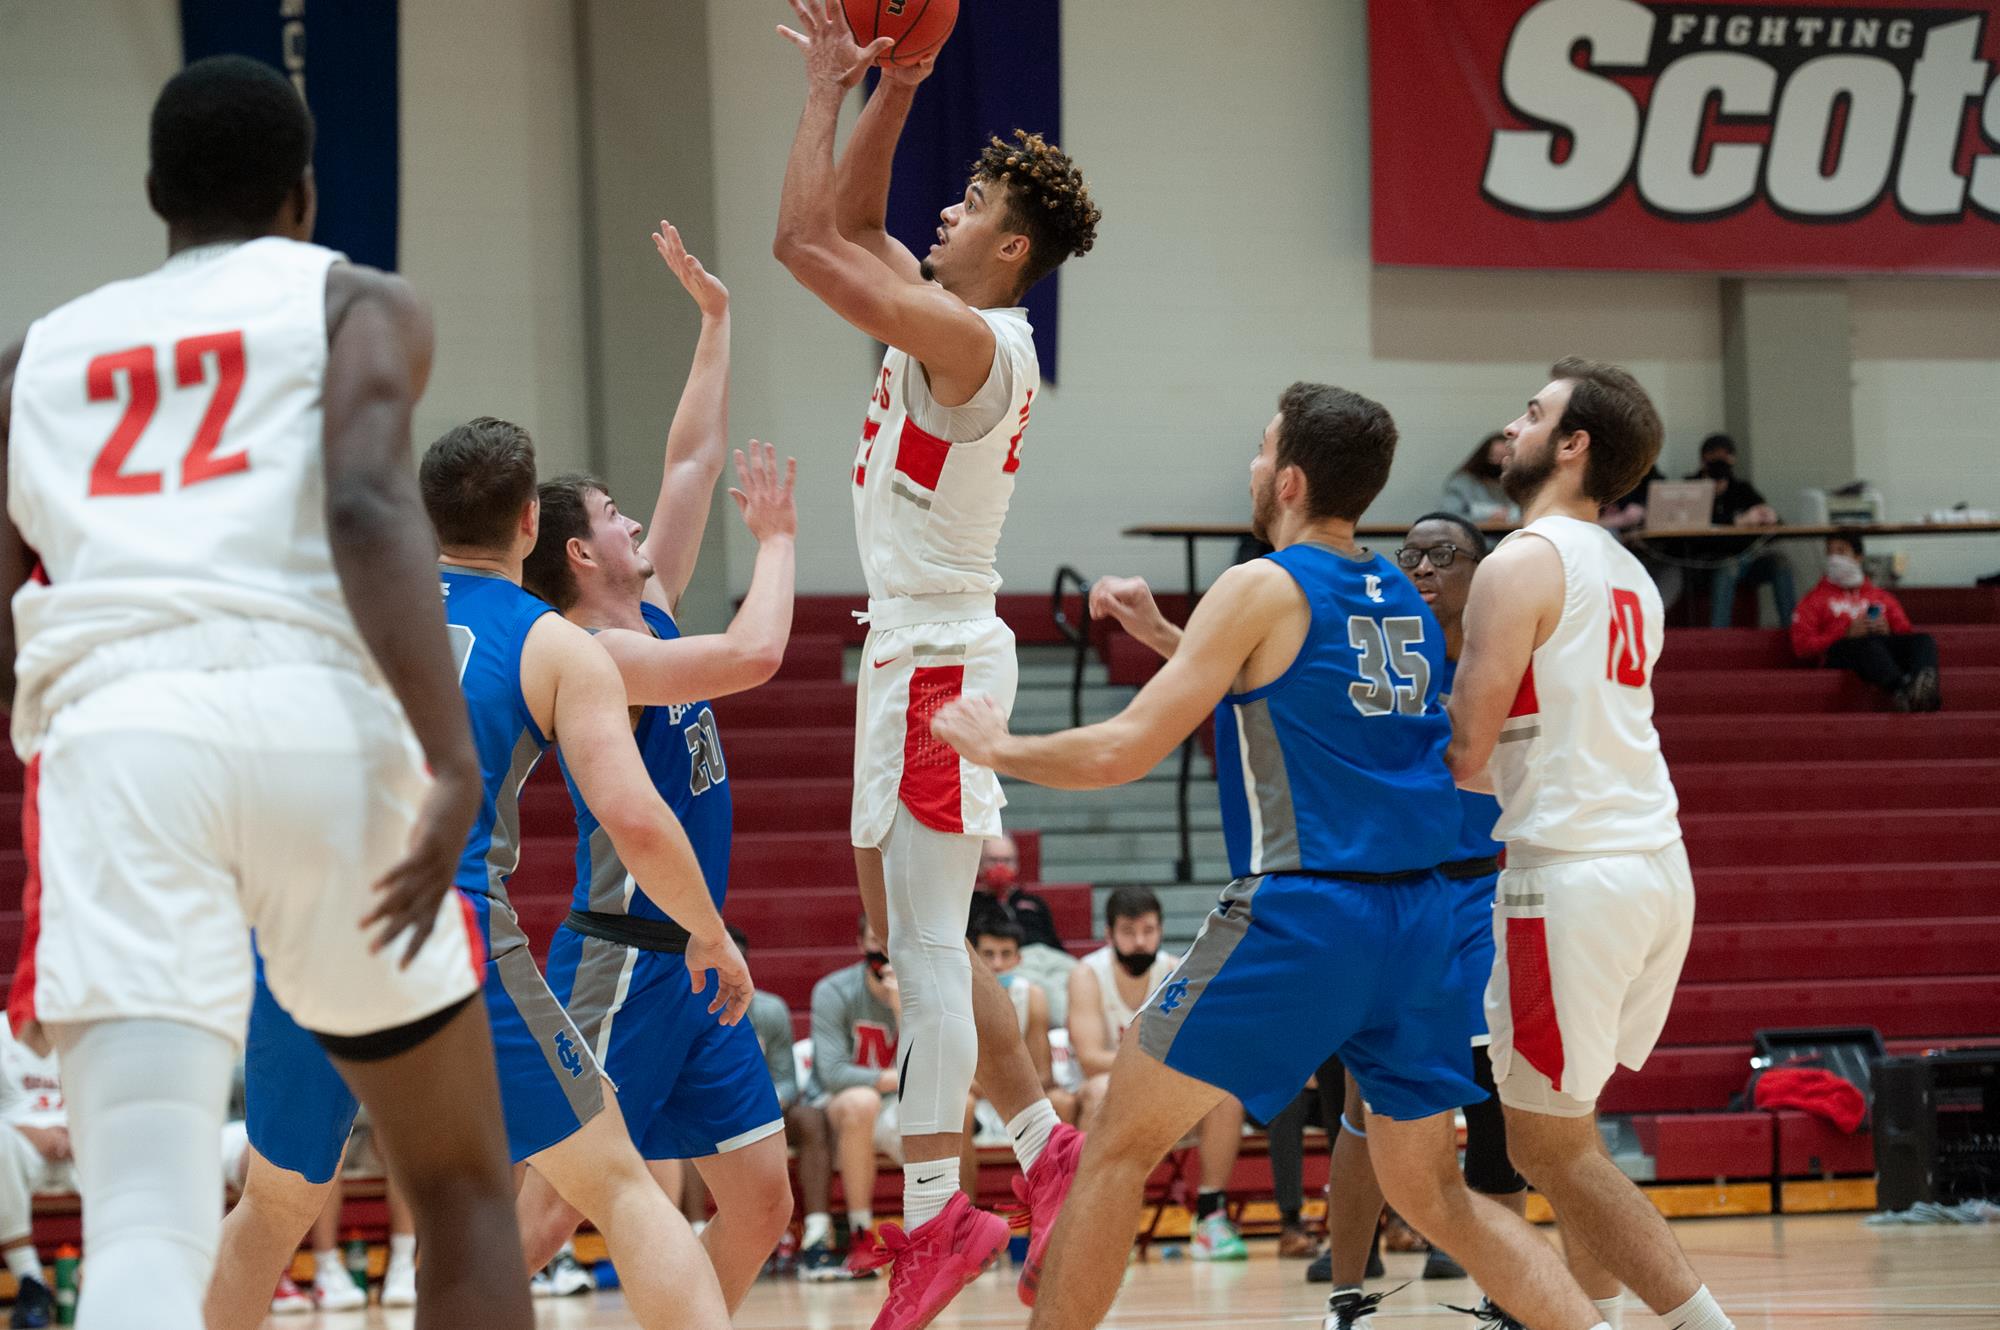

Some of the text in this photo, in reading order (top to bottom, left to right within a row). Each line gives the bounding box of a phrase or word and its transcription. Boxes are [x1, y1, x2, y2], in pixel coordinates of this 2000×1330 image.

[1668, 15, 1915, 49] FIGHTING
[86, 329, 251, 497] 22
[1348, 615, 1430, 717] 35
[684, 706, 725, 797] 20
